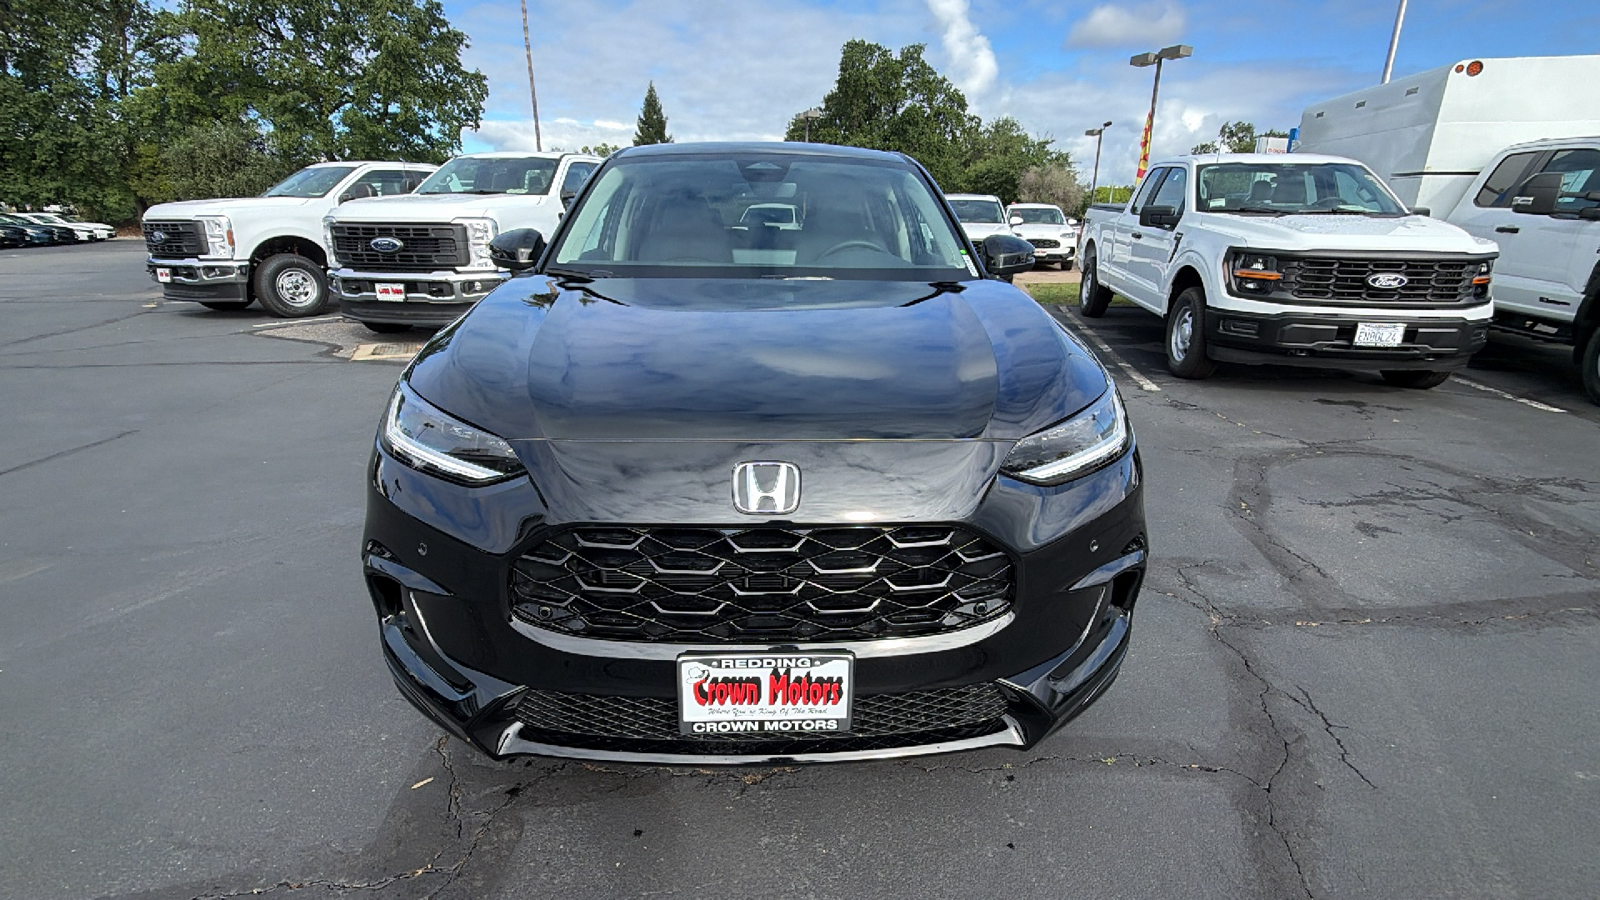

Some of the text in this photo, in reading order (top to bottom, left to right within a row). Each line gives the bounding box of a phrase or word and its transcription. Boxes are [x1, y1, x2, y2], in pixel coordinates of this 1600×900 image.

[721, 658, 811, 669] REDDING
[692, 673, 840, 707] Crown Motors
[707, 707, 731, 715] Where
[758, 707, 777, 716] King
[779, 707, 789, 716] Of
[692, 719, 839, 733] CROWN MOTORS
